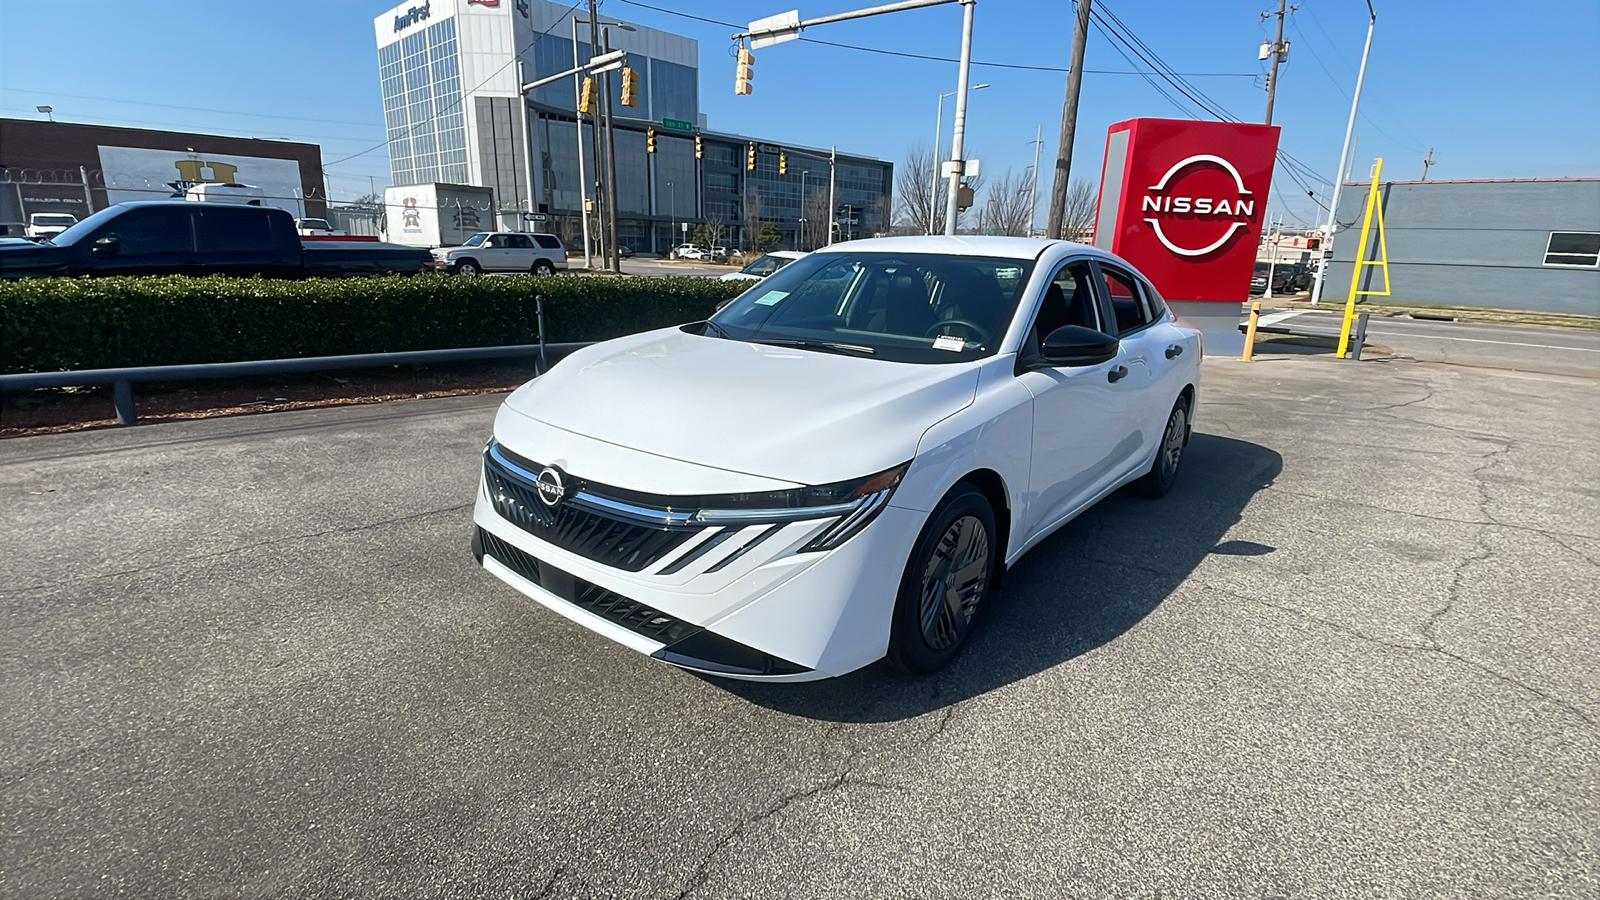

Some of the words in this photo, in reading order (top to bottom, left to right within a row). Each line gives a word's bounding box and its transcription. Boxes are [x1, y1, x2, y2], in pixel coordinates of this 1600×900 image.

[394, 0, 430, 33] AmFirst
[1142, 195, 1254, 216] NISSAN
[536, 480, 564, 496] NSSAN
